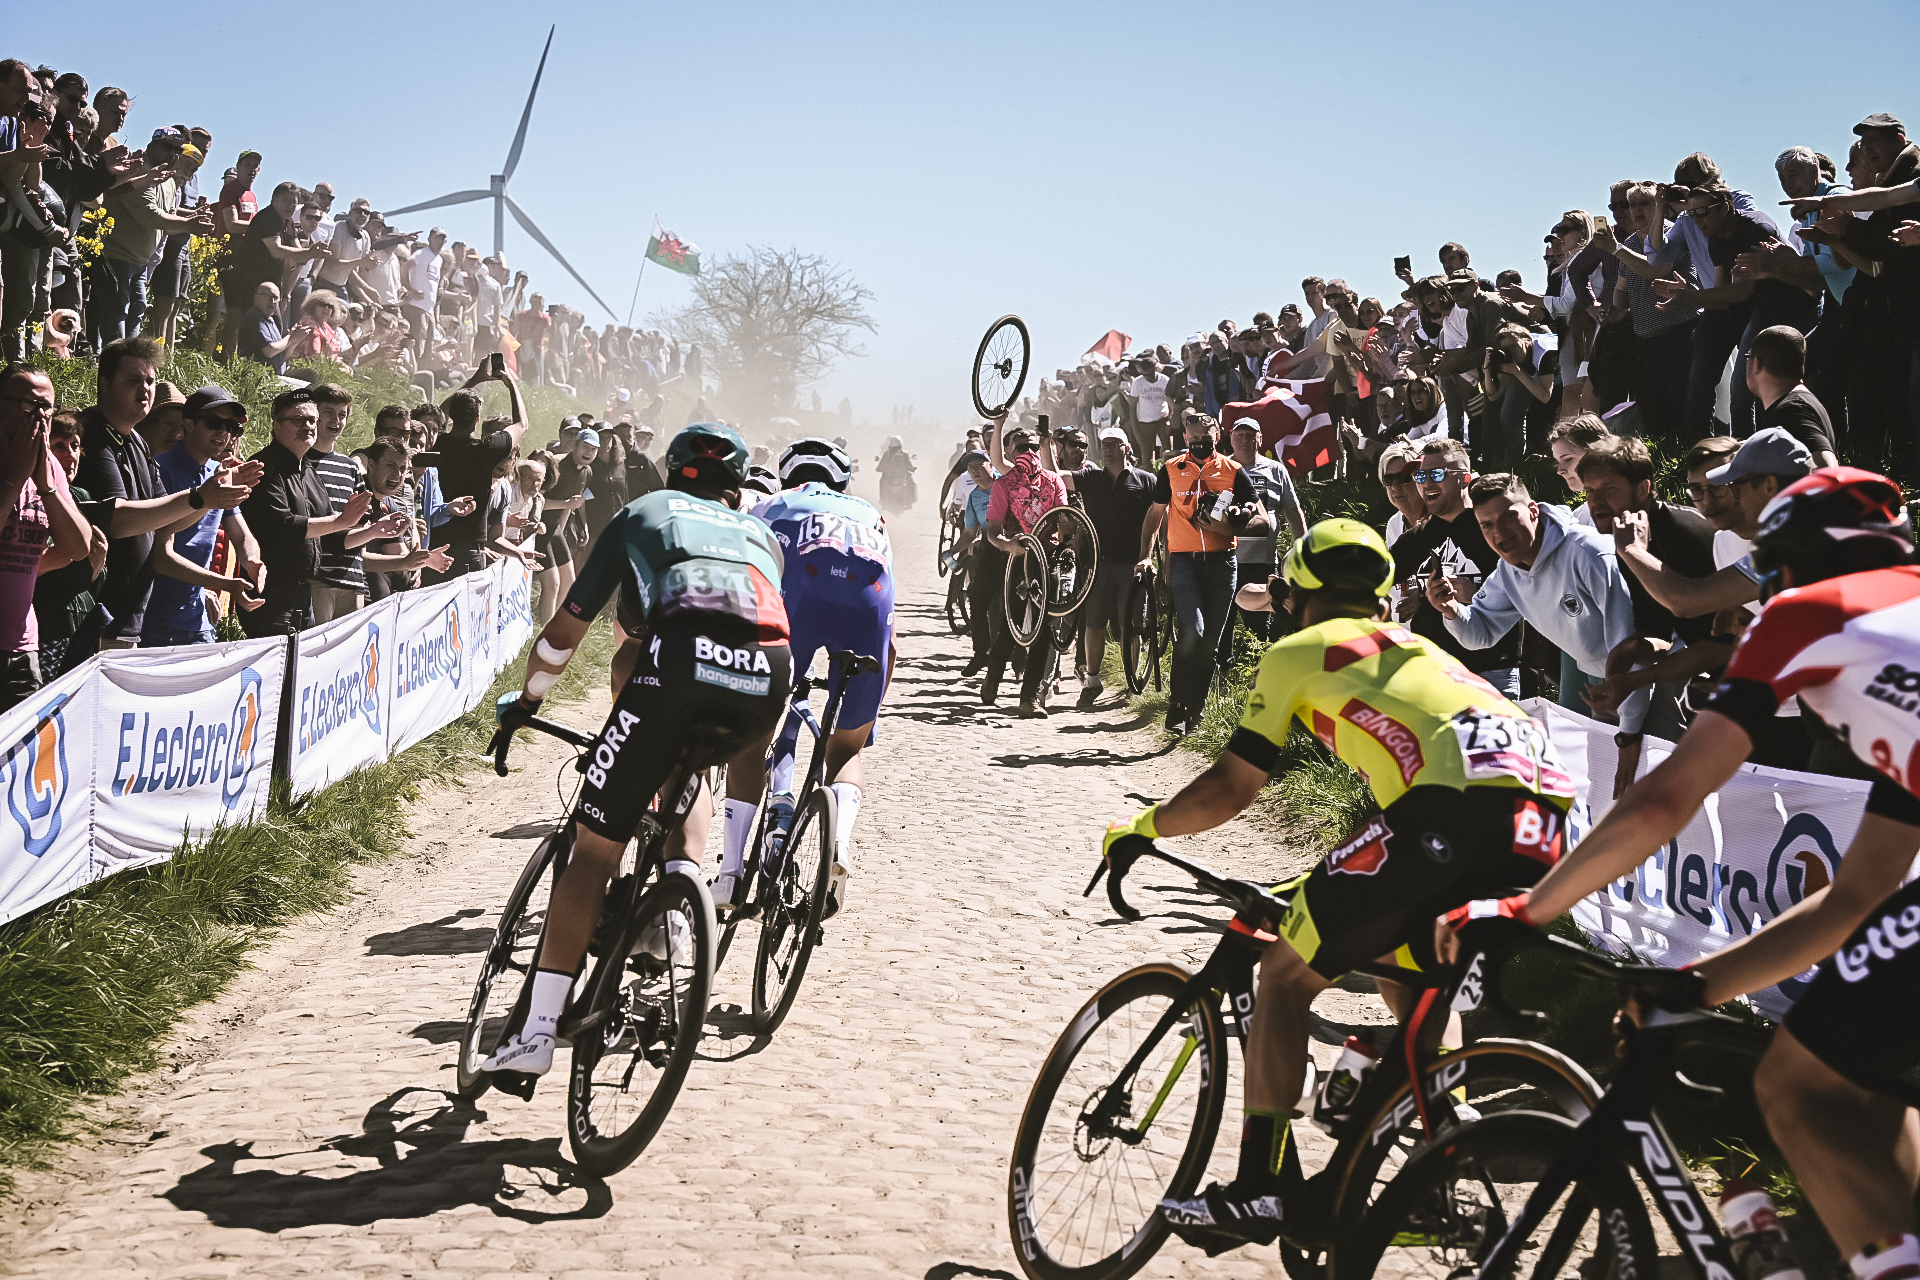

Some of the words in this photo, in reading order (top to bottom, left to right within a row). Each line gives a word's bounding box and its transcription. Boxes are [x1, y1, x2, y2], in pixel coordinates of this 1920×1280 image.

[801, 513, 844, 543] 152
[397, 629, 447, 699] E.Leclerc
[695, 637, 772, 674] BORA
[643, 677, 661, 687] COL
[697, 666, 769, 693] hansgrohe
[298, 668, 361, 756] E.Leclerc
[111, 711, 229, 797] E.Leclerc
[586, 709, 641, 790] BORA
[1350, 709, 1420, 781] BINGOAL
[584, 803, 607, 824] COL
[1515, 808, 1557, 852] B!
